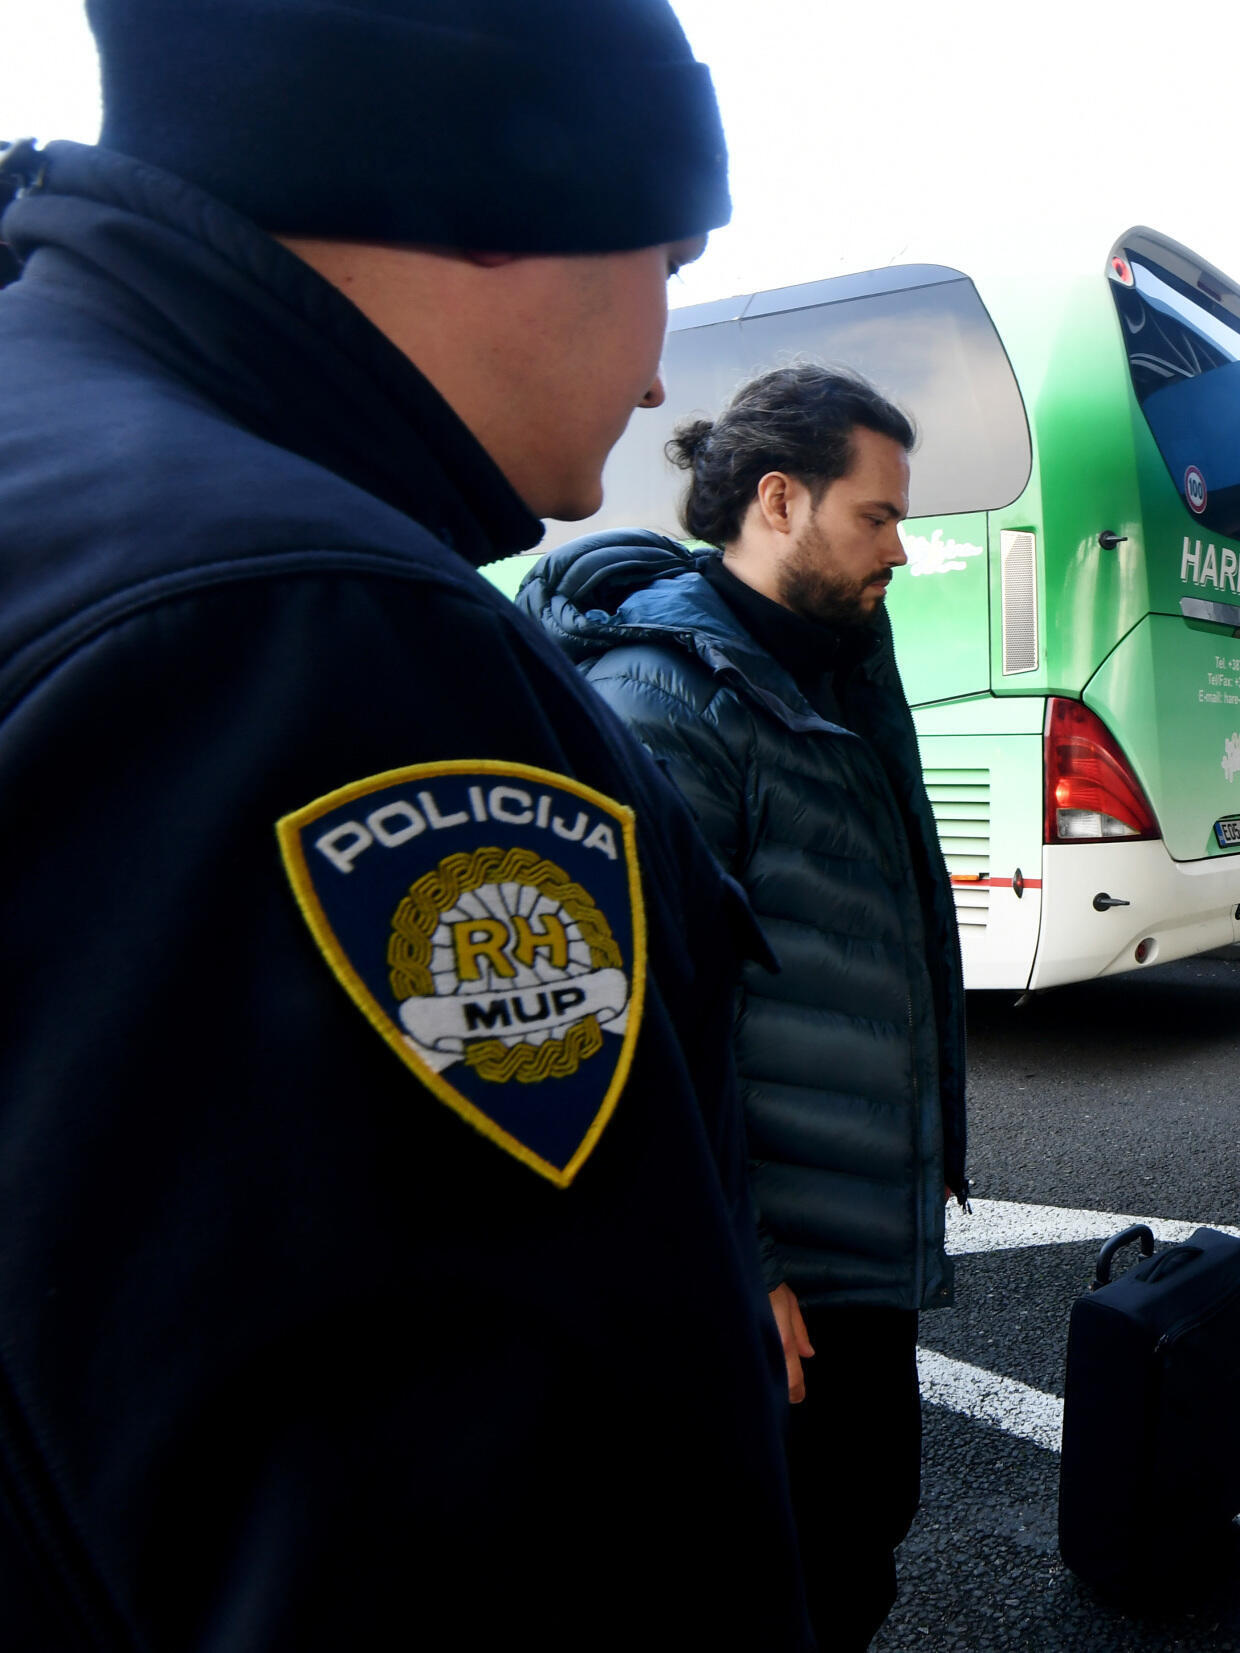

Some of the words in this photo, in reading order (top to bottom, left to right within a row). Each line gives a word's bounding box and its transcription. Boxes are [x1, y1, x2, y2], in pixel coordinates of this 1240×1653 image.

[1189, 478, 1203, 500] 100
[314, 785, 619, 874] POLICIJA
[453, 914, 569, 982] RH
[462, 987, 587, 1031] MUP
